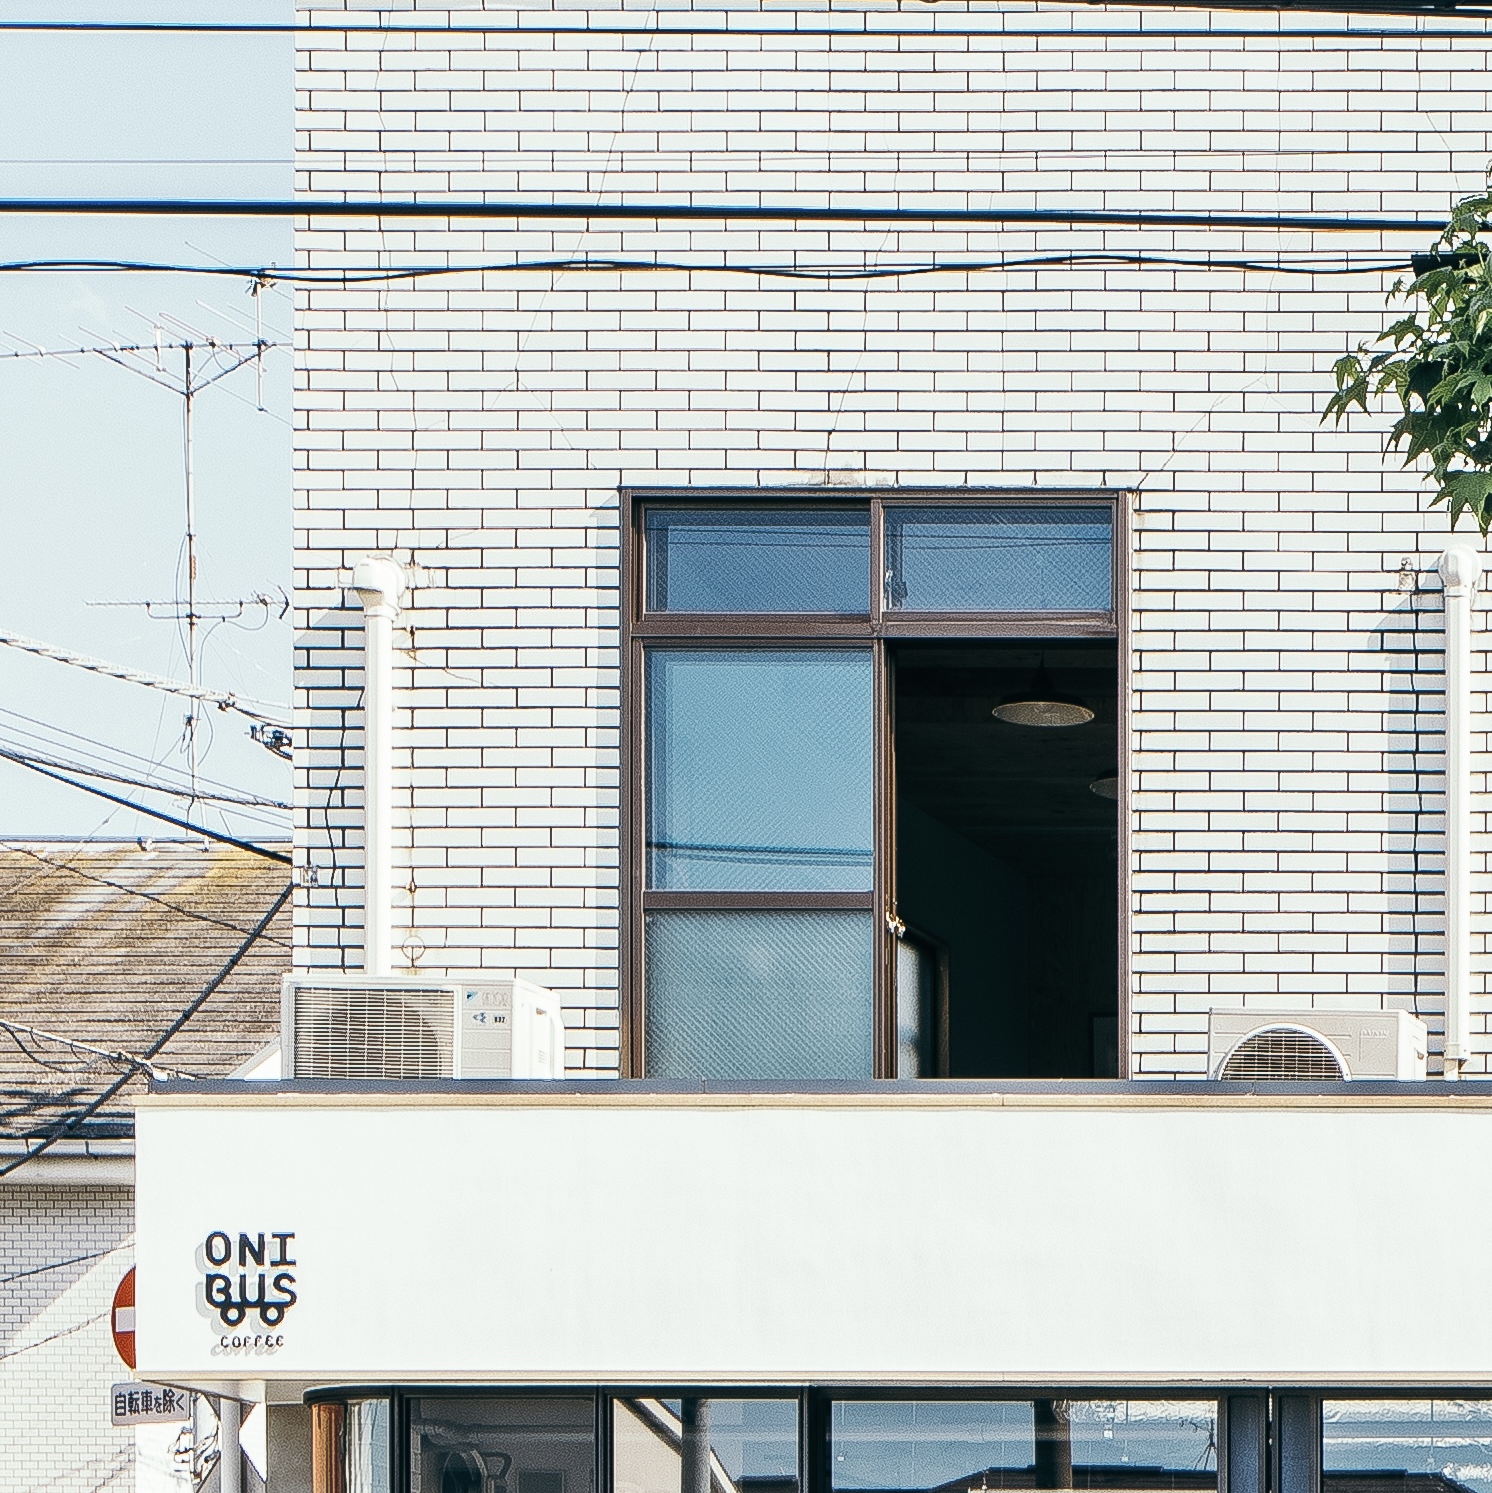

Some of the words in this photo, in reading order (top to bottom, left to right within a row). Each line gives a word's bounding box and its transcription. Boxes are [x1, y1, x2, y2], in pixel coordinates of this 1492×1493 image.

[205, 1231, 297, 1268] ONI
[205, 1272, 298, 1327] BUS
[114, 1388, 185, 1417] 自転車を除く
